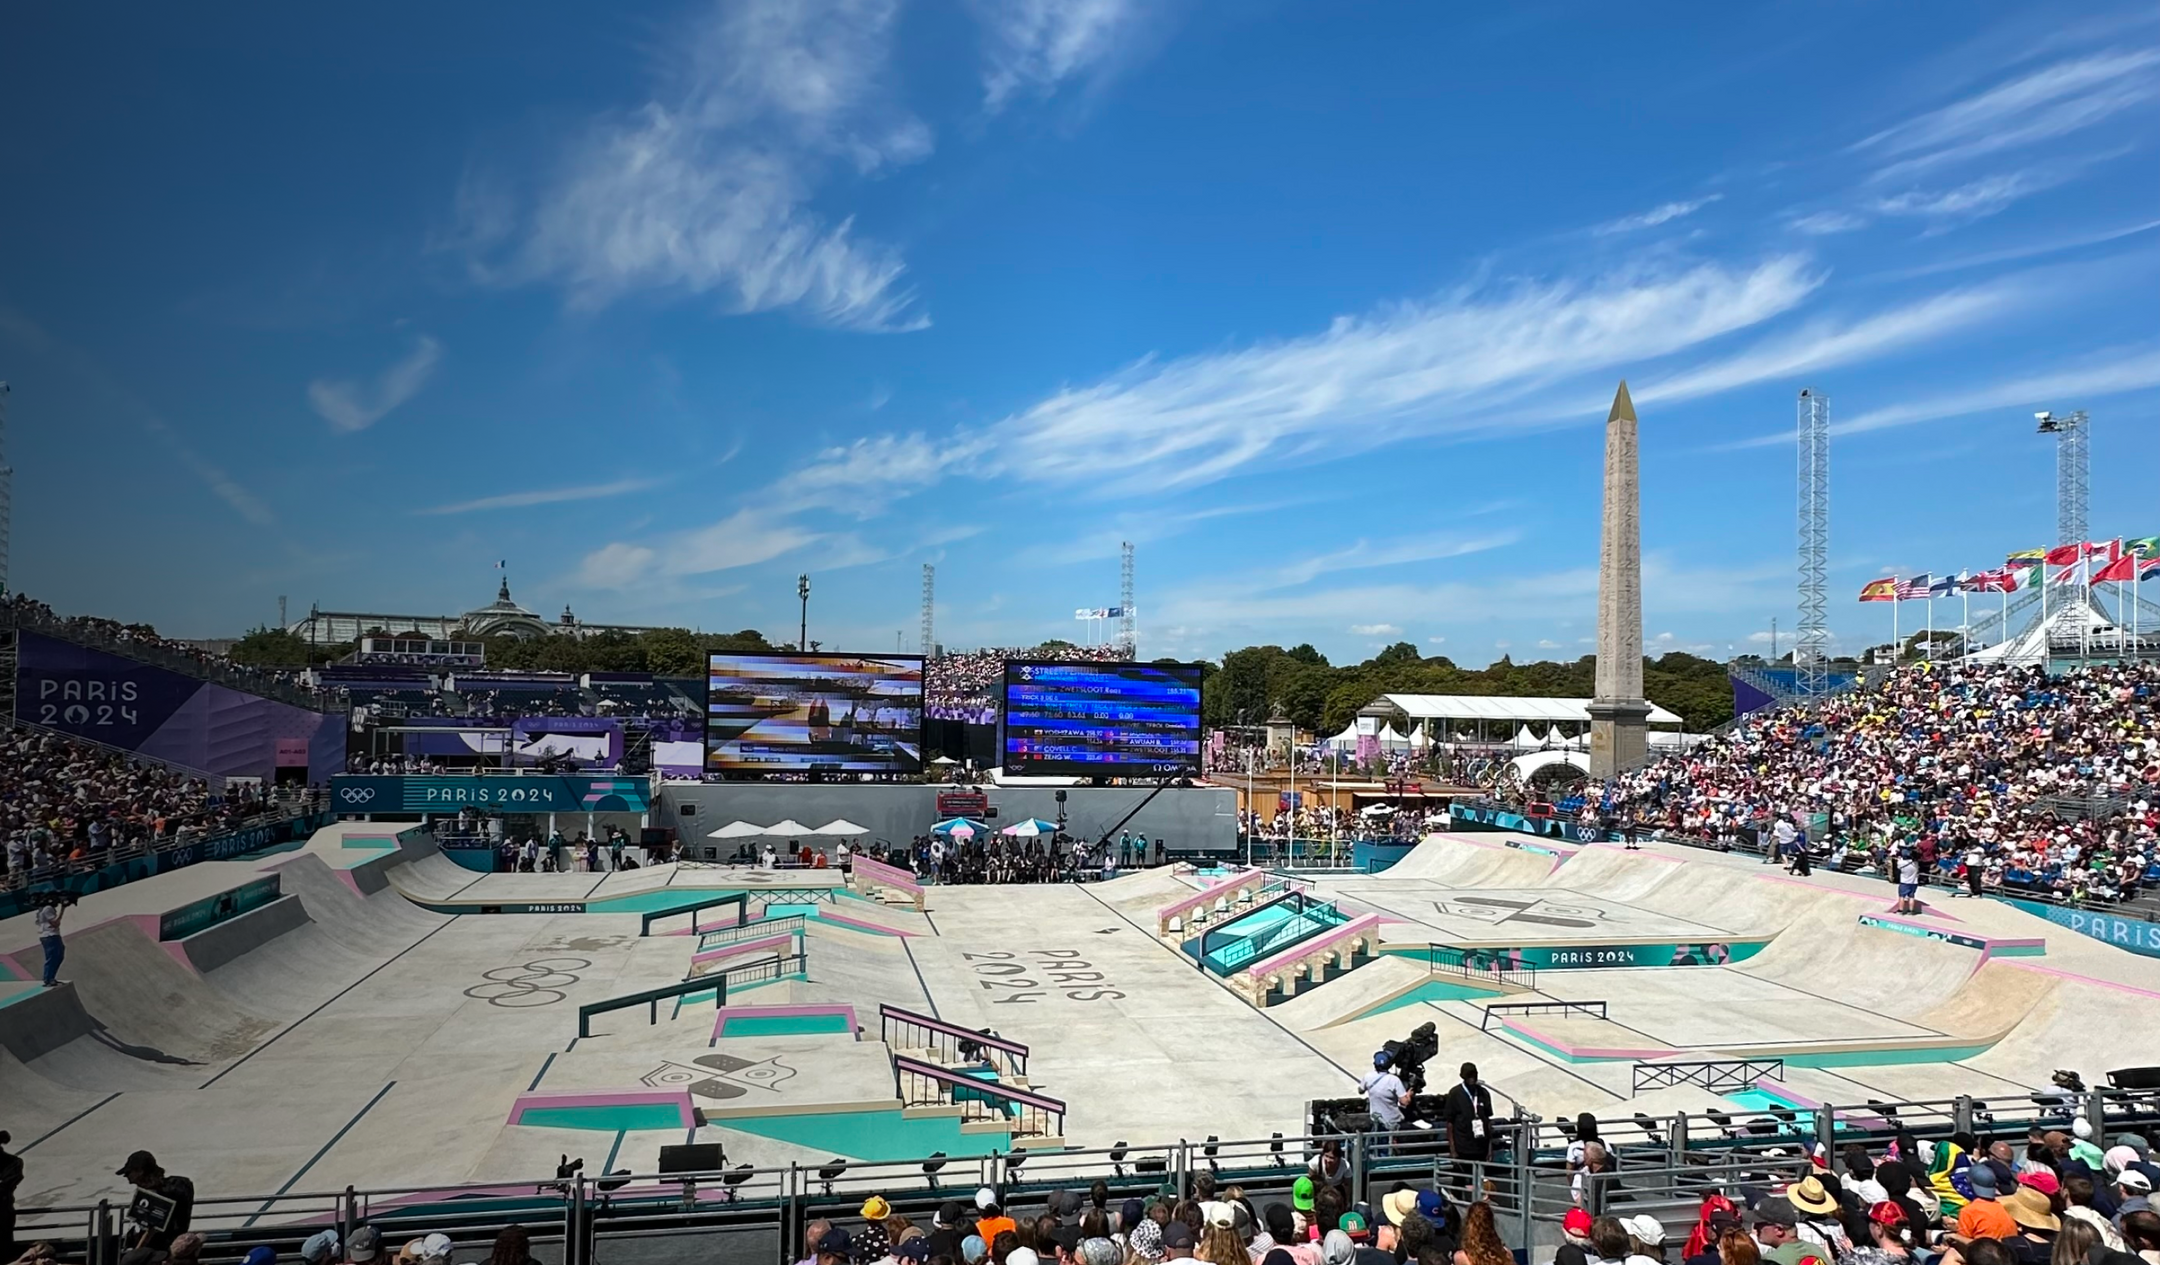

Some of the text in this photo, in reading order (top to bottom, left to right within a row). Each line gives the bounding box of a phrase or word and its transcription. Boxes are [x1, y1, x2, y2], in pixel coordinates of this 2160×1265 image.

[40, 704, 137, 725] 2024
[497, 788, 553, 801] 2024
[1597, 950, 1634, 963] 2024
[1431, 1206, 1440, 1215] C
